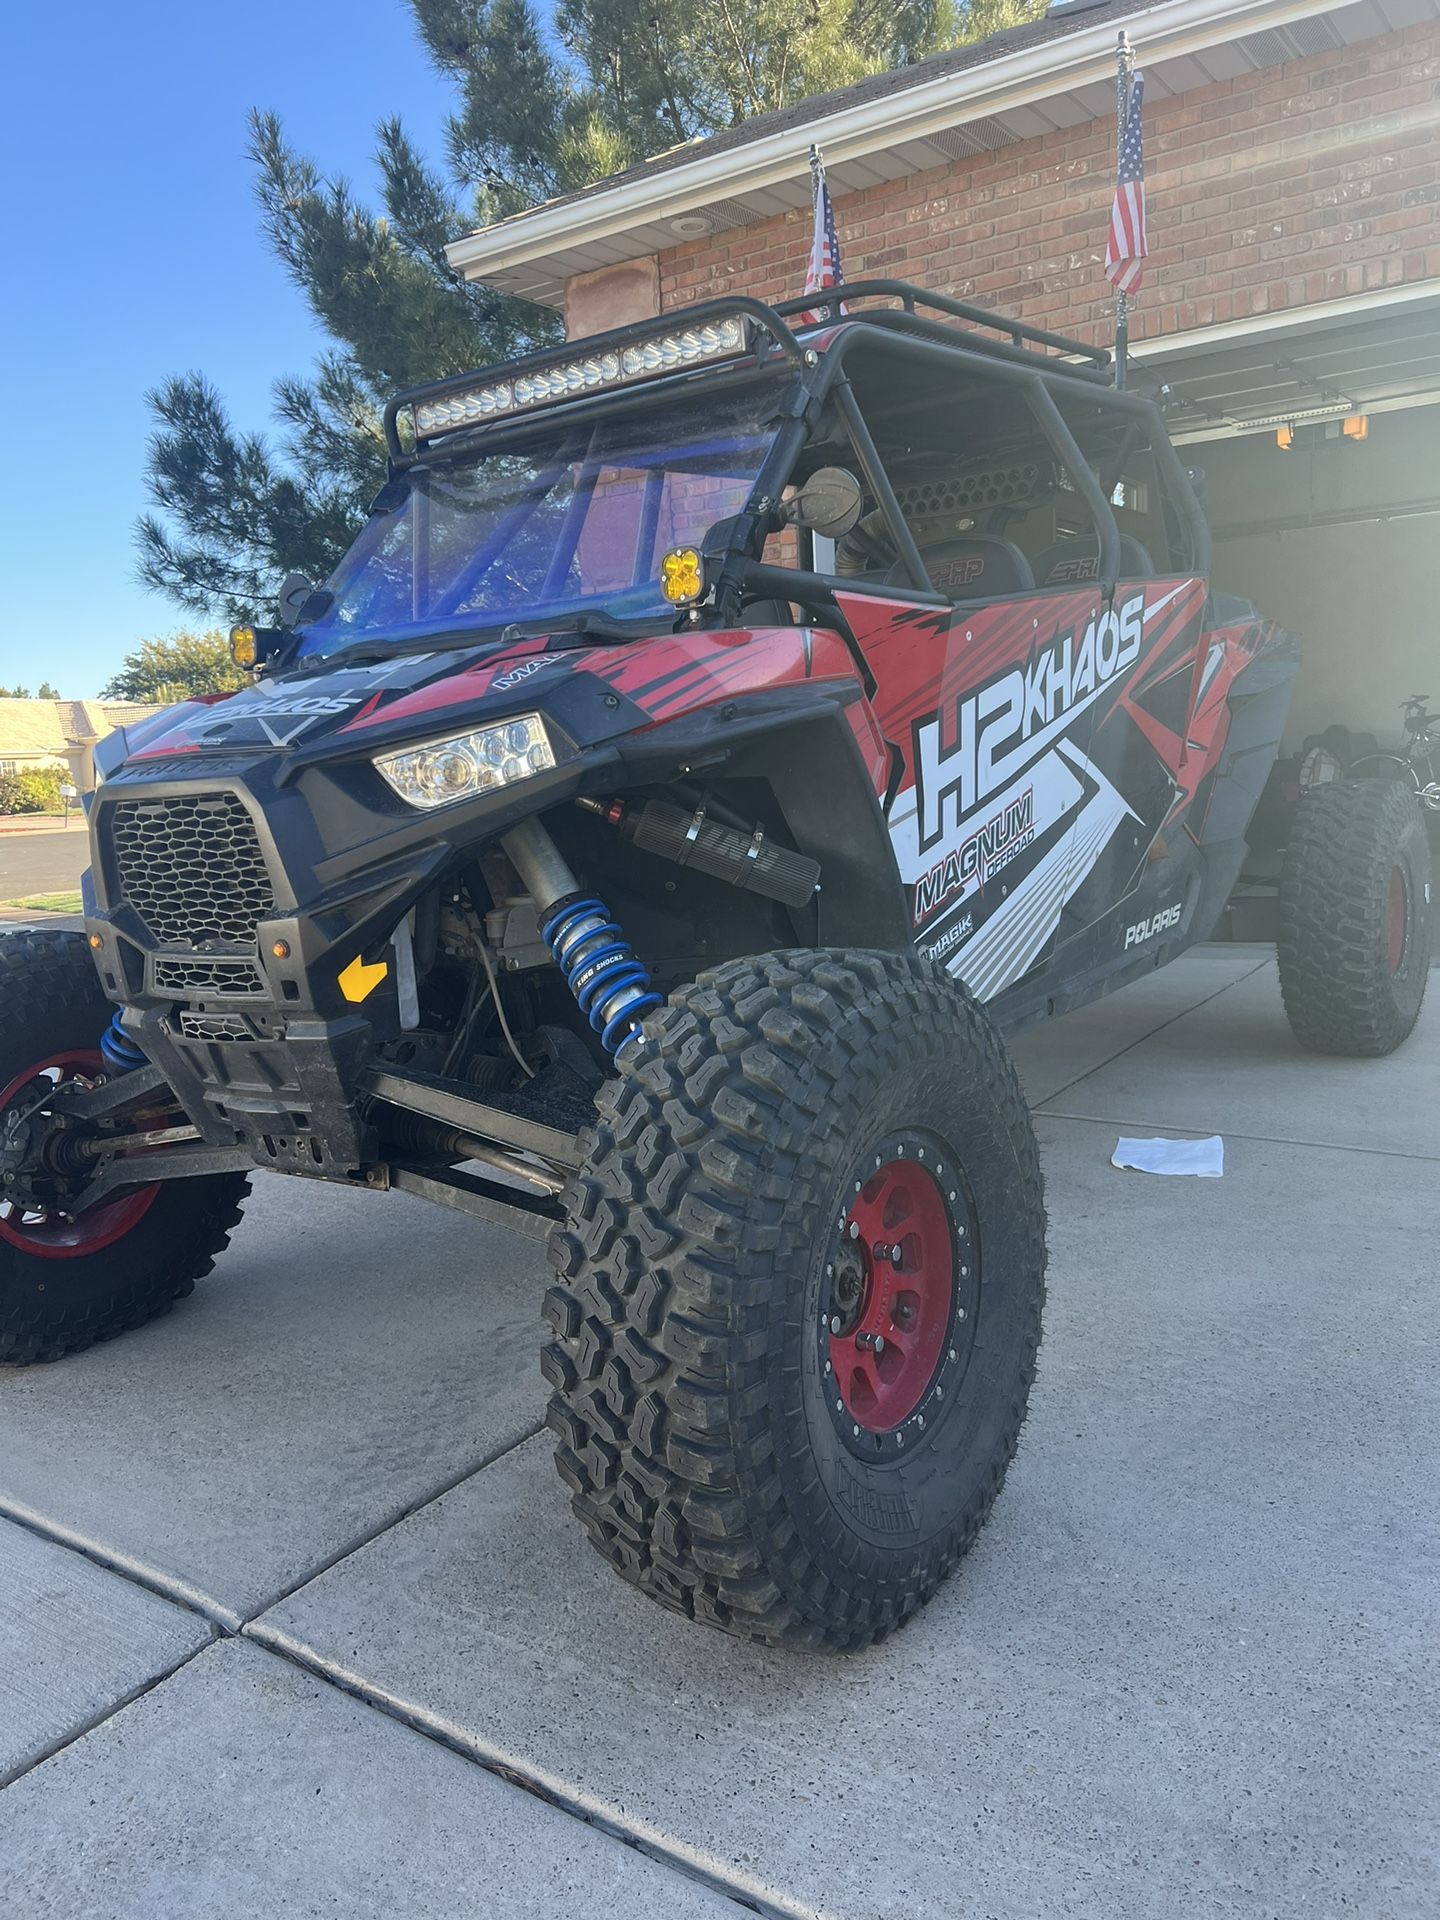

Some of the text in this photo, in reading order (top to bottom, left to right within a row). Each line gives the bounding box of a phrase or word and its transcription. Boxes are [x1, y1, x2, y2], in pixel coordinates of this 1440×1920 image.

[919, 594, 1145, 842] H2KHAOS
[913, 788, 1034, 927] MAGNUM
[986, 828, 1035, 880] OFFROAD
[928, 912, 973, 961] MAGIK
[1124, 902, 1182, 950] POLARIS
[576, 954, 624, 988] KING SHOCKS
